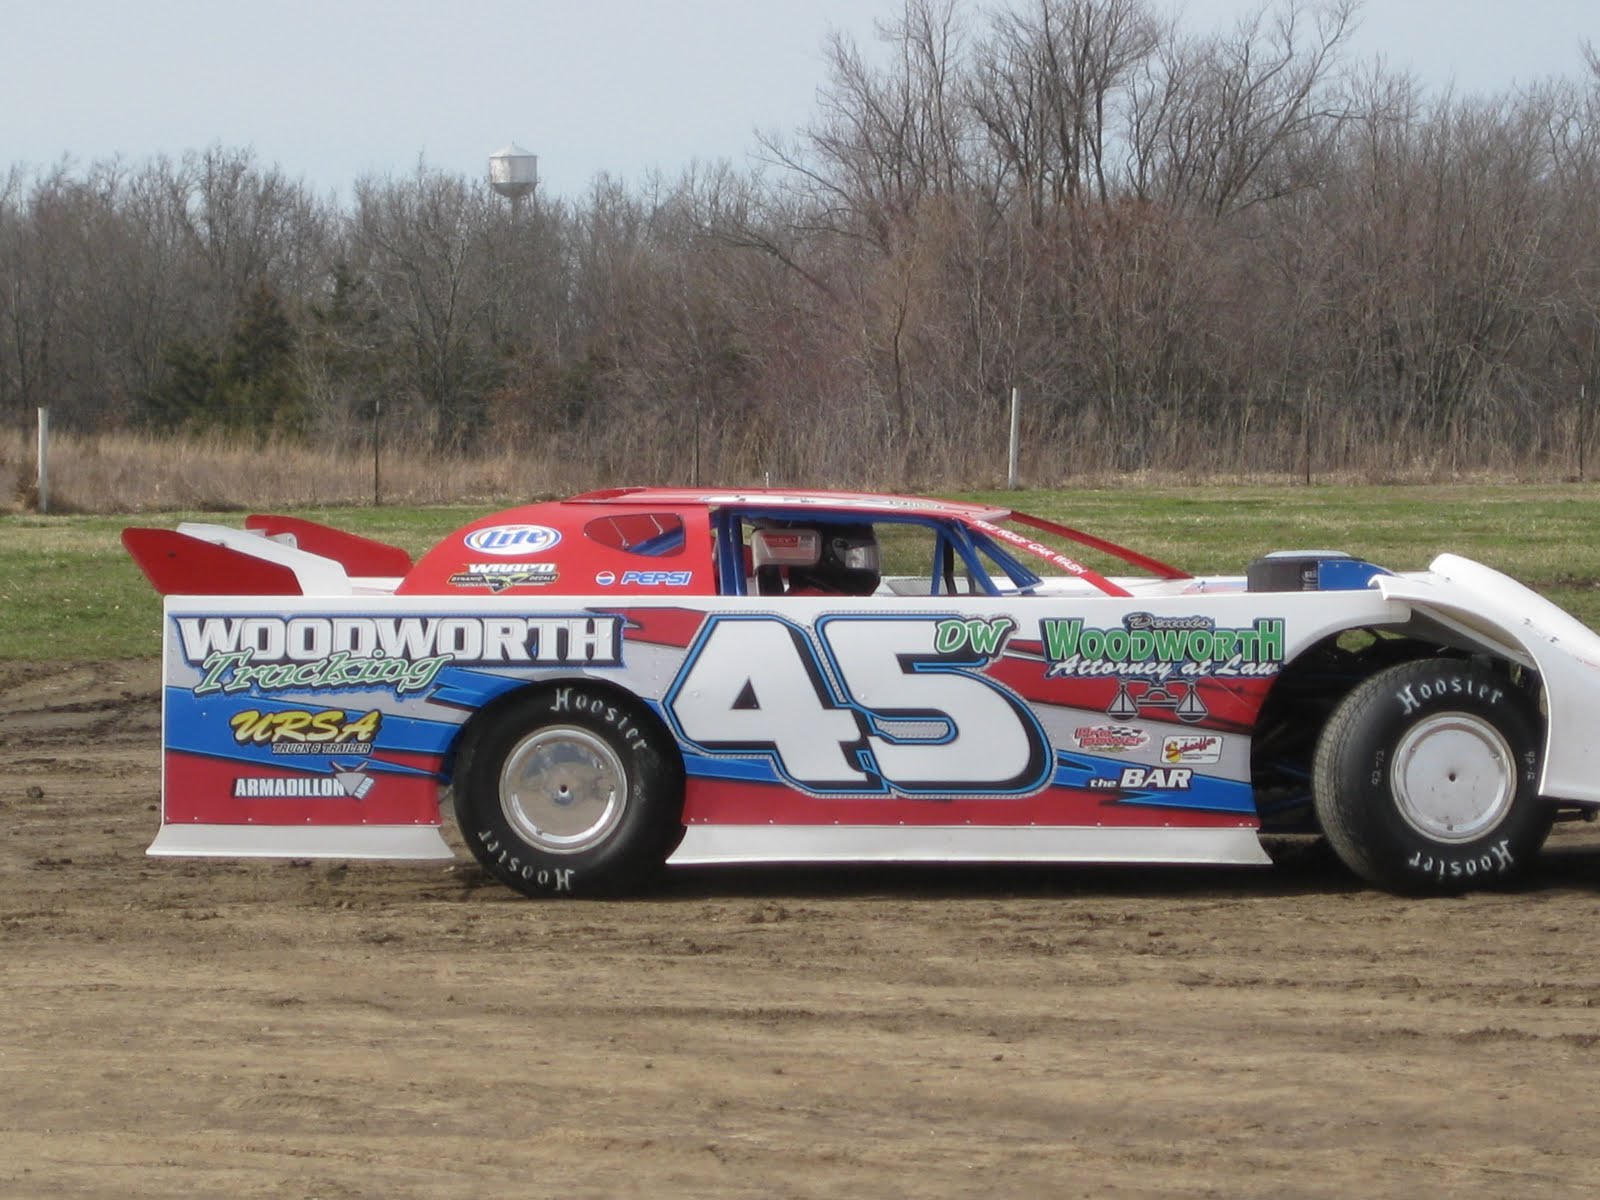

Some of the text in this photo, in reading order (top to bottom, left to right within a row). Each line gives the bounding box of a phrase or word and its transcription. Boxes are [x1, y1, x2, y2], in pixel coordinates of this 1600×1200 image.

[480, 530, 551, 549] Lite
[621, 571, 692, 585] PEPSI
[177, 616, 616, 662] WOODWORTH
[934, 618, 1013, 654] DW
[1128, 613, 1212, 629] Dennis
[1044, 619, 1283, 662] WOODWORTH
[193, 648, 454, 694] Trucking
[1048, 654, 1281, 680] Attorney at Law
[668, 617, 1036, 785] 45
[1396, 677, 1503, 714] Hoosier
[230, 711, 381, 743] URSA
[551, 687, 649, 750] Hoosier
[272, 742, 311, 754] TRUCK
[321, 742, 371, 754] TRAILER
[1090, 768, 1193, 788] the BAR
[478, 830, 575, 891] Hoosier
[1408, 840, 1515, 877] Hoosier
